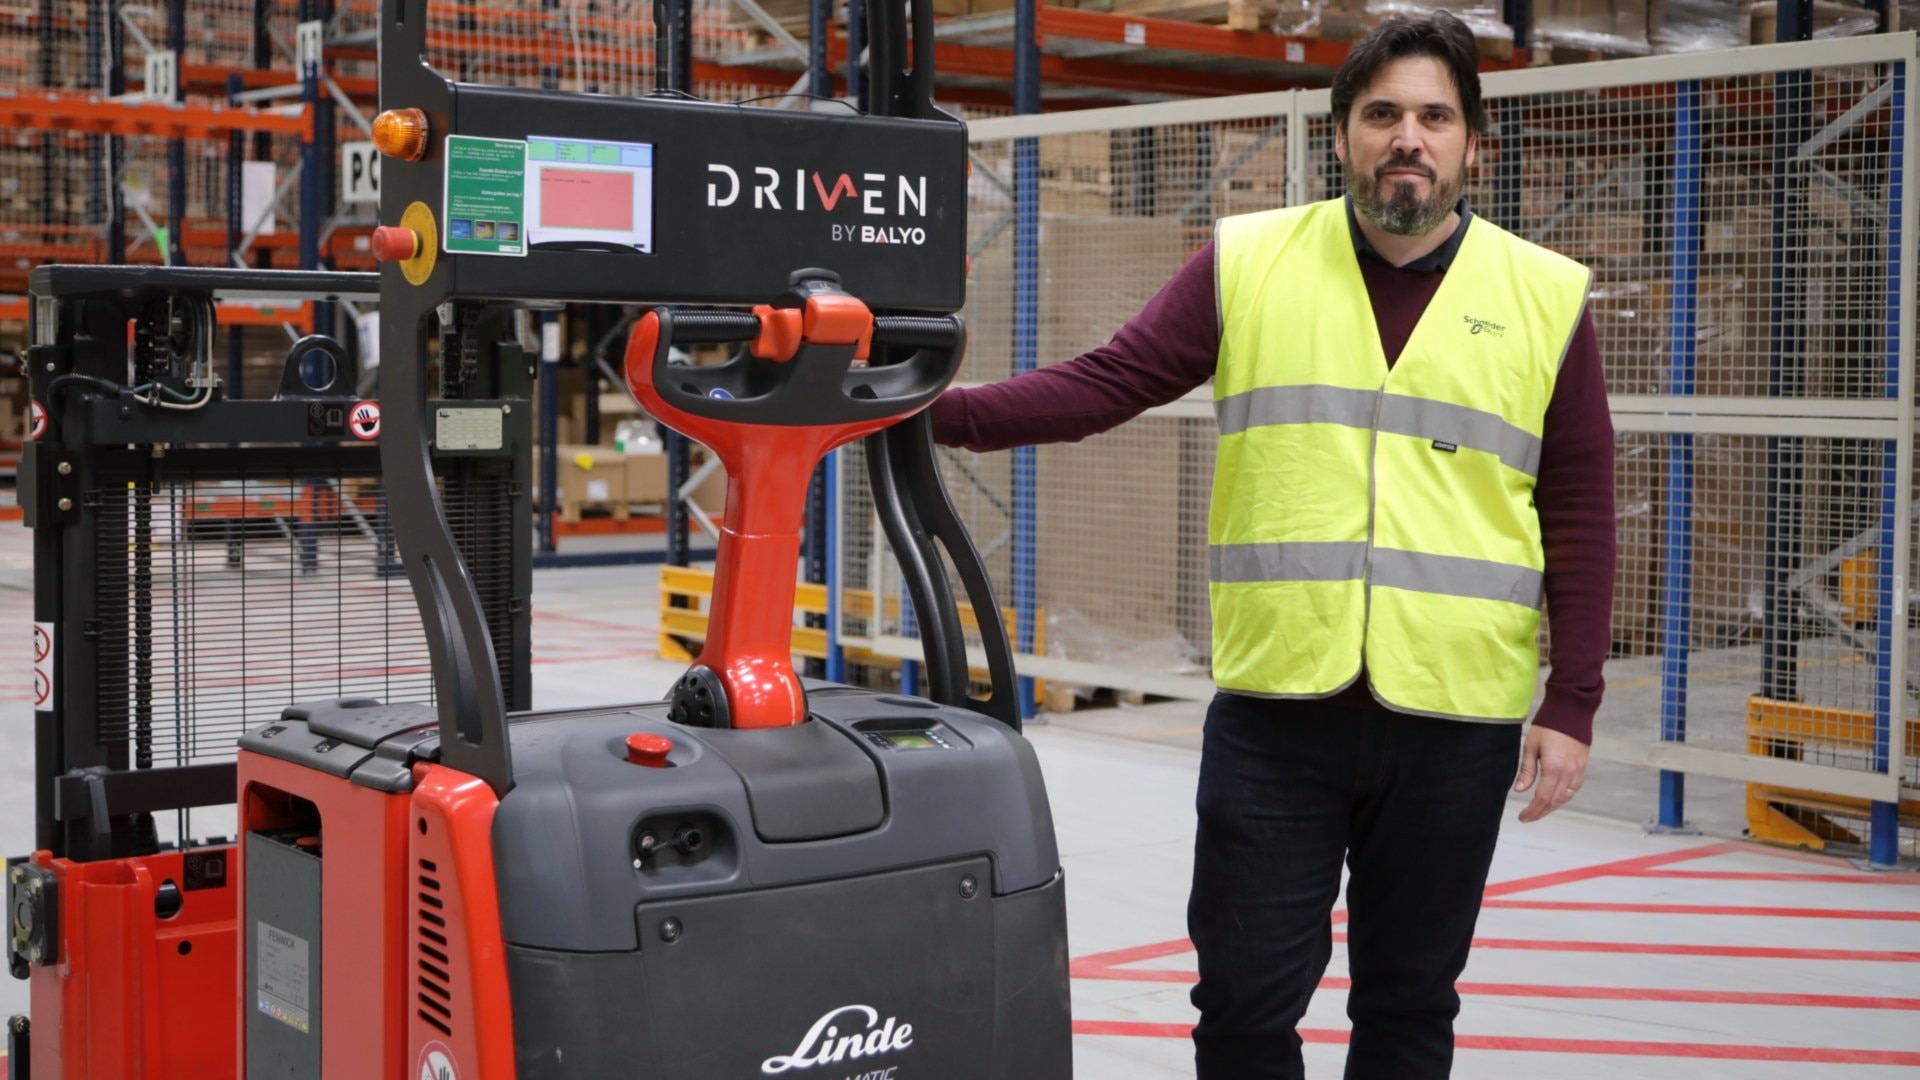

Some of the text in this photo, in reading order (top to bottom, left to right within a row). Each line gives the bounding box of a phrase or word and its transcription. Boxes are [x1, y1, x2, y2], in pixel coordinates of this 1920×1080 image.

[707, 163, 927, 217] DRIVEN
[831, 223, 926, 245] BY BALYO
[761, 1004, 913, 1074] Linde
